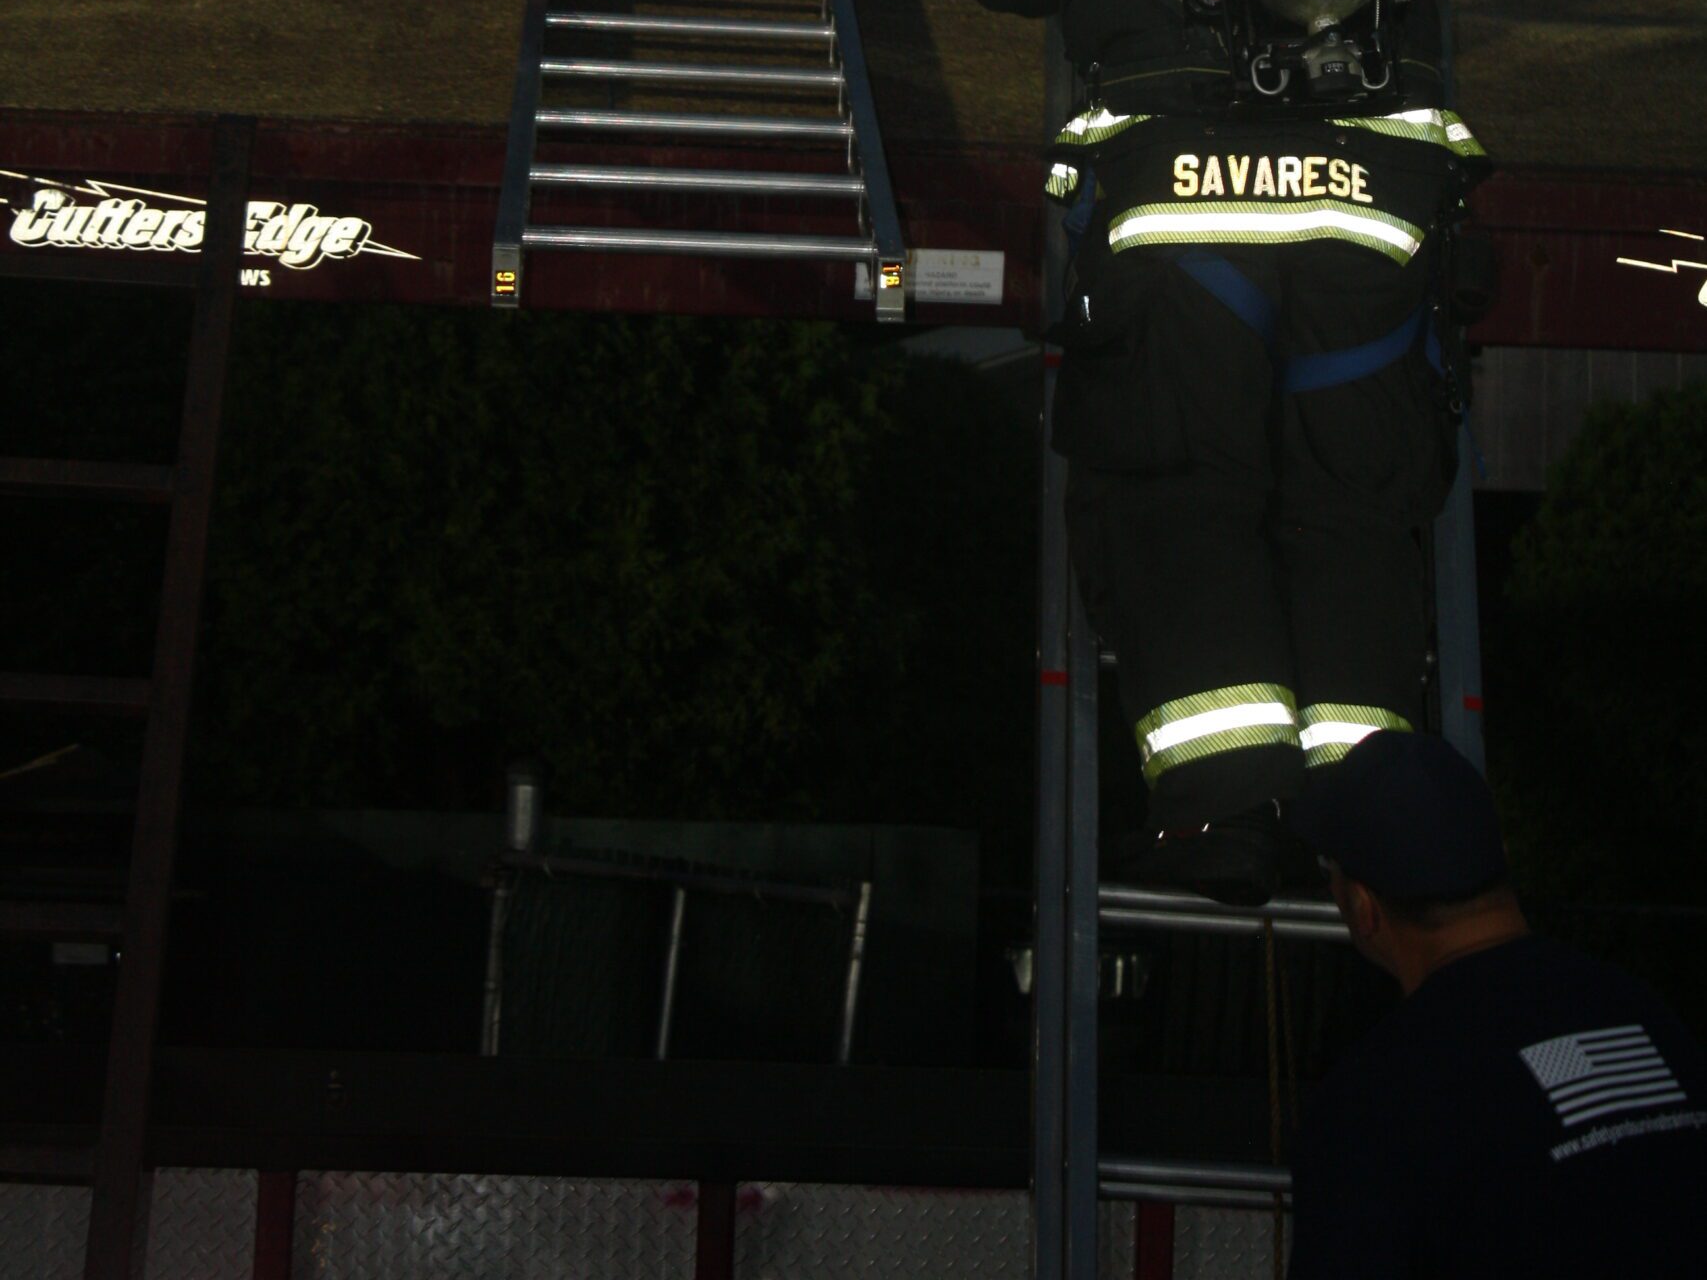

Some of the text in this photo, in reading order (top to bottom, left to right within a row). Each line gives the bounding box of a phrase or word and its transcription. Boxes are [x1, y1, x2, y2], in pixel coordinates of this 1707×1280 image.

[1173, 154, 1374, 203] SAVARESE
[9, 188, 372, 269] Cutters Edge
[241, 268, 271, 287] WS
[496, 271, 516, 293] 16
